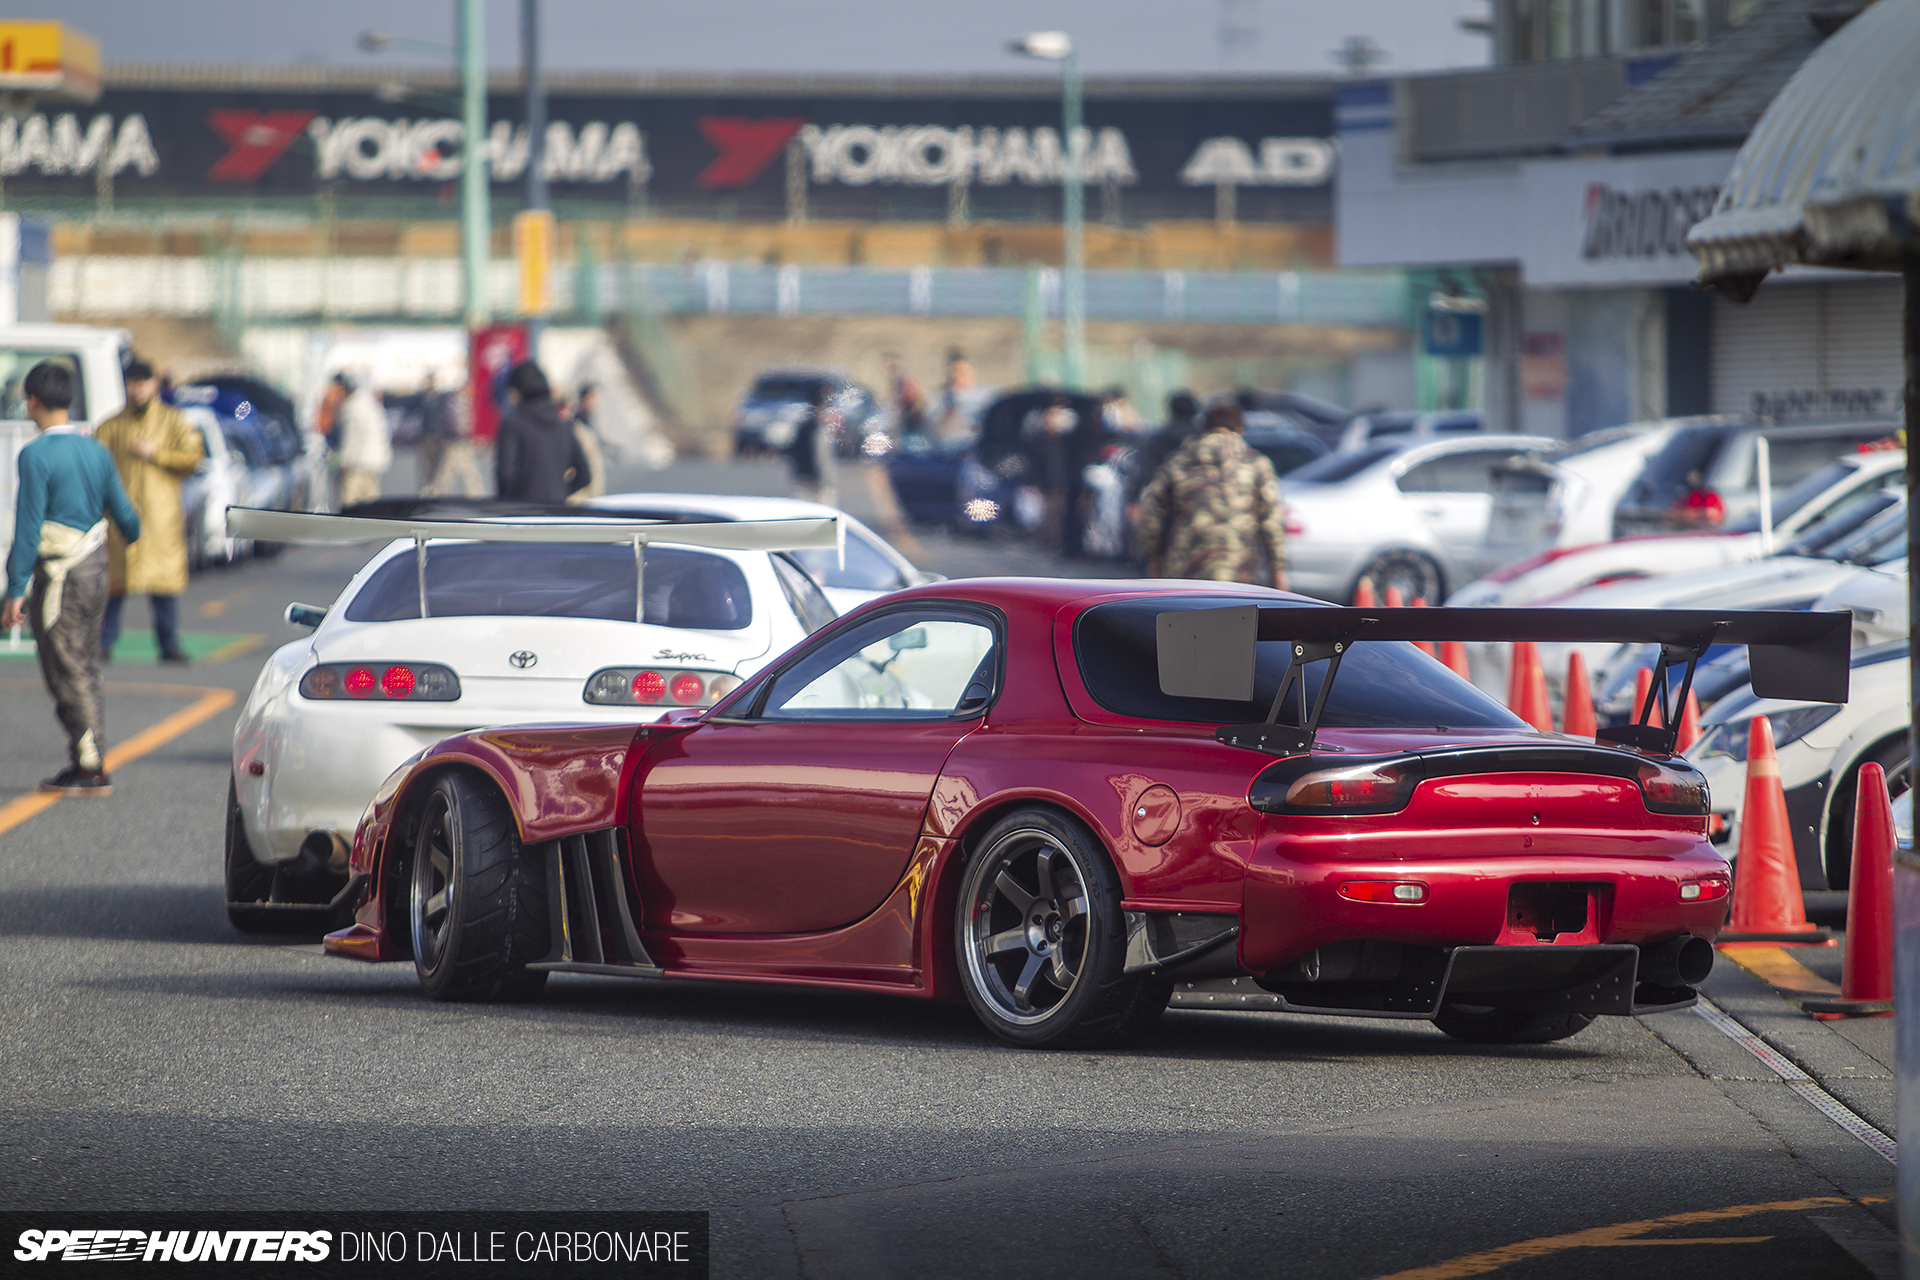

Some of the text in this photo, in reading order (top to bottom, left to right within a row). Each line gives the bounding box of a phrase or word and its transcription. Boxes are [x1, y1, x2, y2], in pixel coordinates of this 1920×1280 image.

[801, 123, 1140, 187] YOKOHAMA
[1180, 136, 1339, 187] AD
[651, 648, 716, 664] Supra
